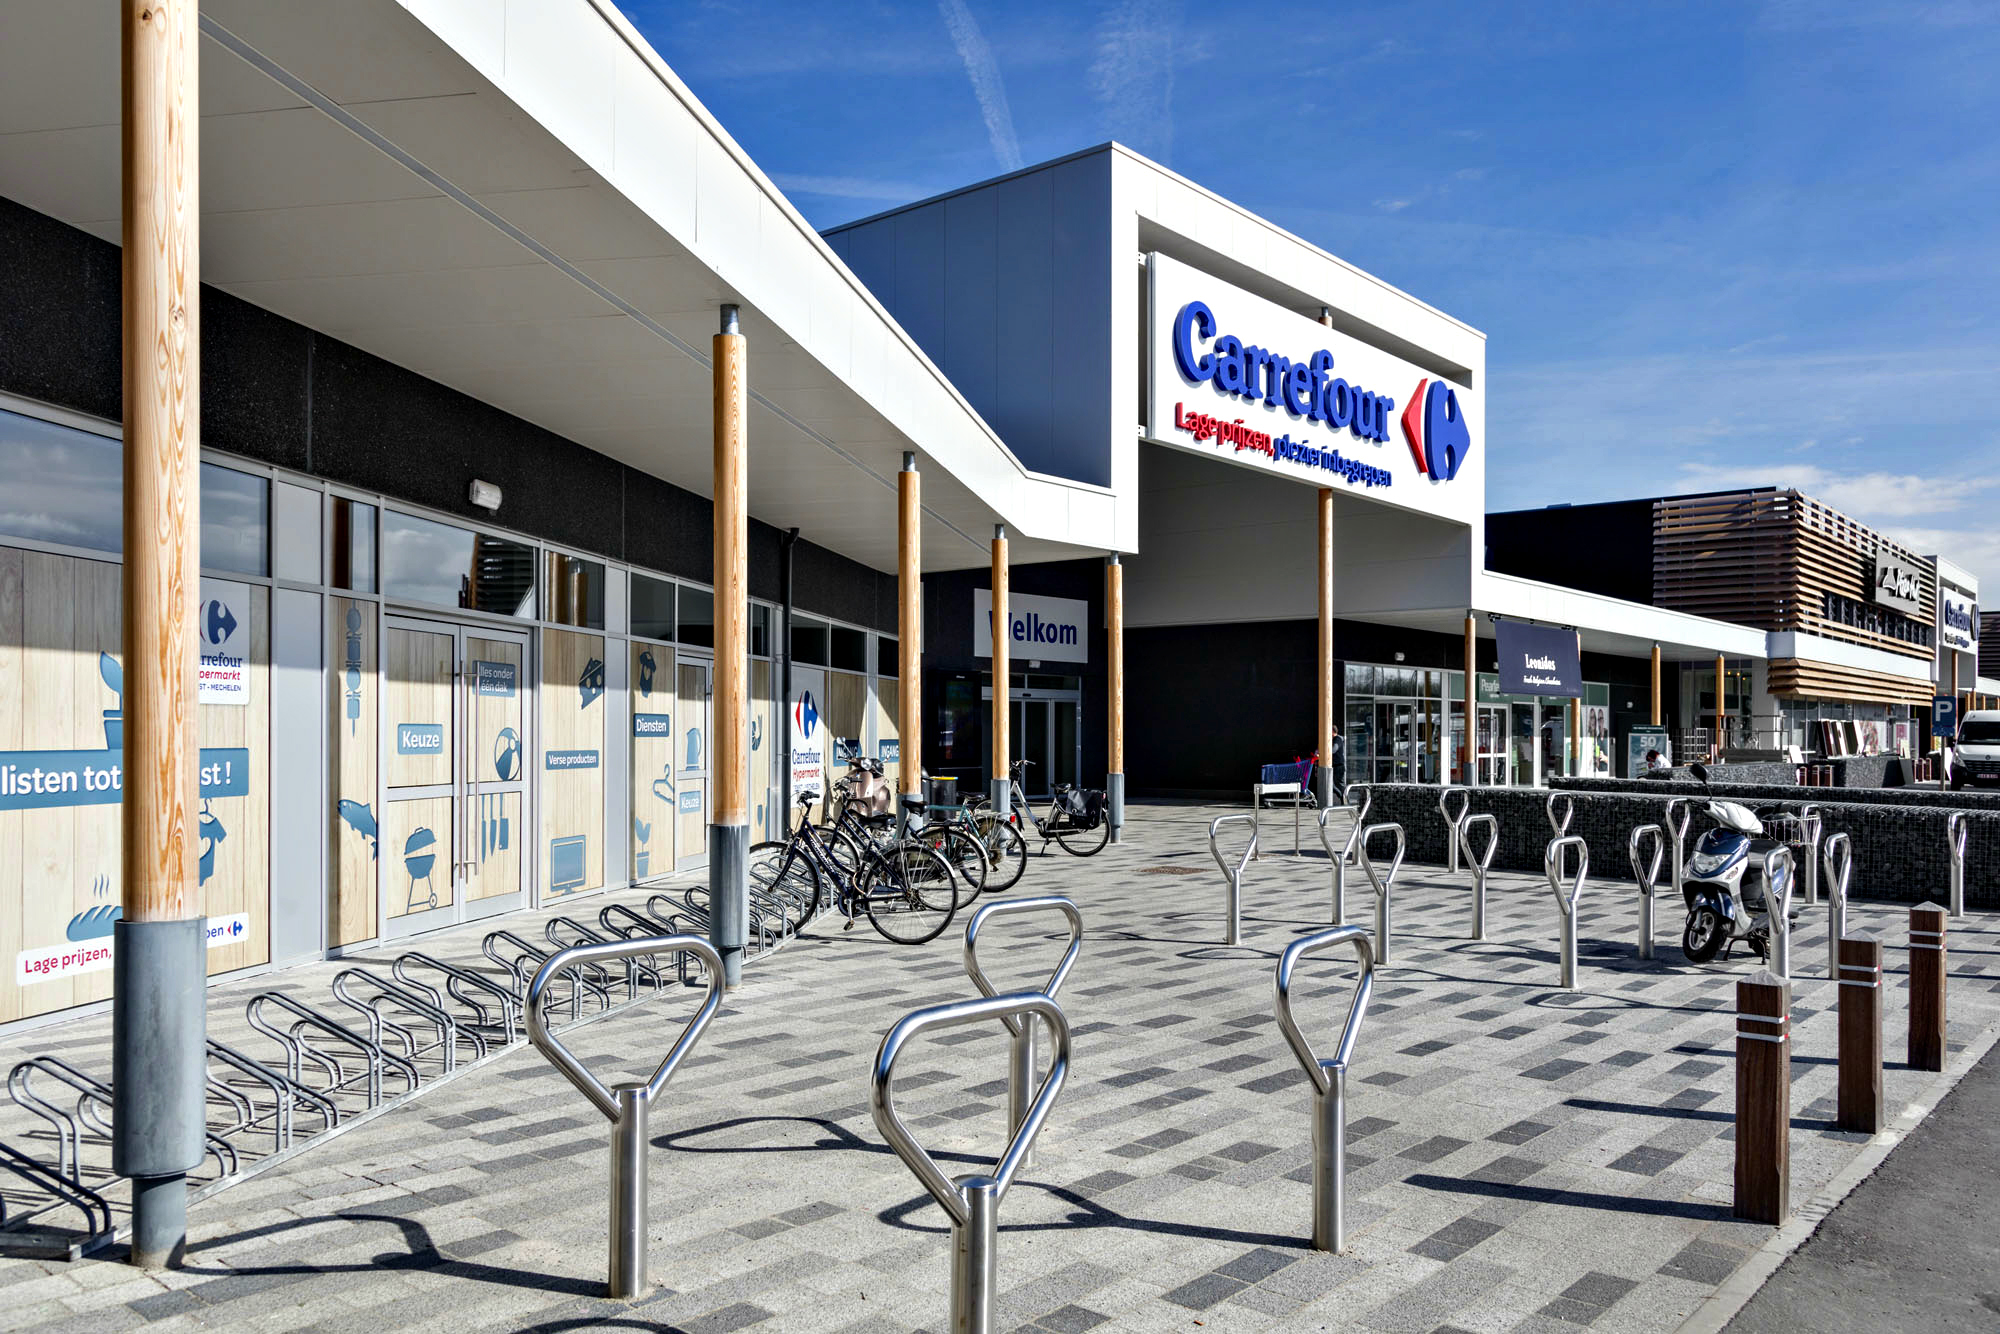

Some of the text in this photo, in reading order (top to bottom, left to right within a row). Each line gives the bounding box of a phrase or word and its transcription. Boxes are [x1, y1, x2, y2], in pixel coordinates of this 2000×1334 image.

[1172, 301, 1394, 442] Carrefour
[1175, 402, 1392, 487] Lage prijzen, plezier inbegrepen
[200, 652, 242, 667] rrefour
[1524, 653, 1556, 671] Leonidas
[199, 670, 240, 680] permarkt
[480, 666, 493, 678] lles
[495, 681, 508, 692] dak
[1935, 701, 1952, 721] P
[636, 718, 667, 733] Diensten
[402, 730, 440, 748] Keuze
[548, 753, 597, 767] Verse producten
[792, 747, 821, 765] Carrefour
[1, 764, 78, 795] listen
[83, 765, 122, 791] tot
[681, 797, 700, 809] Keuze
[25, 947, 112, 975] Lage prijzen,
